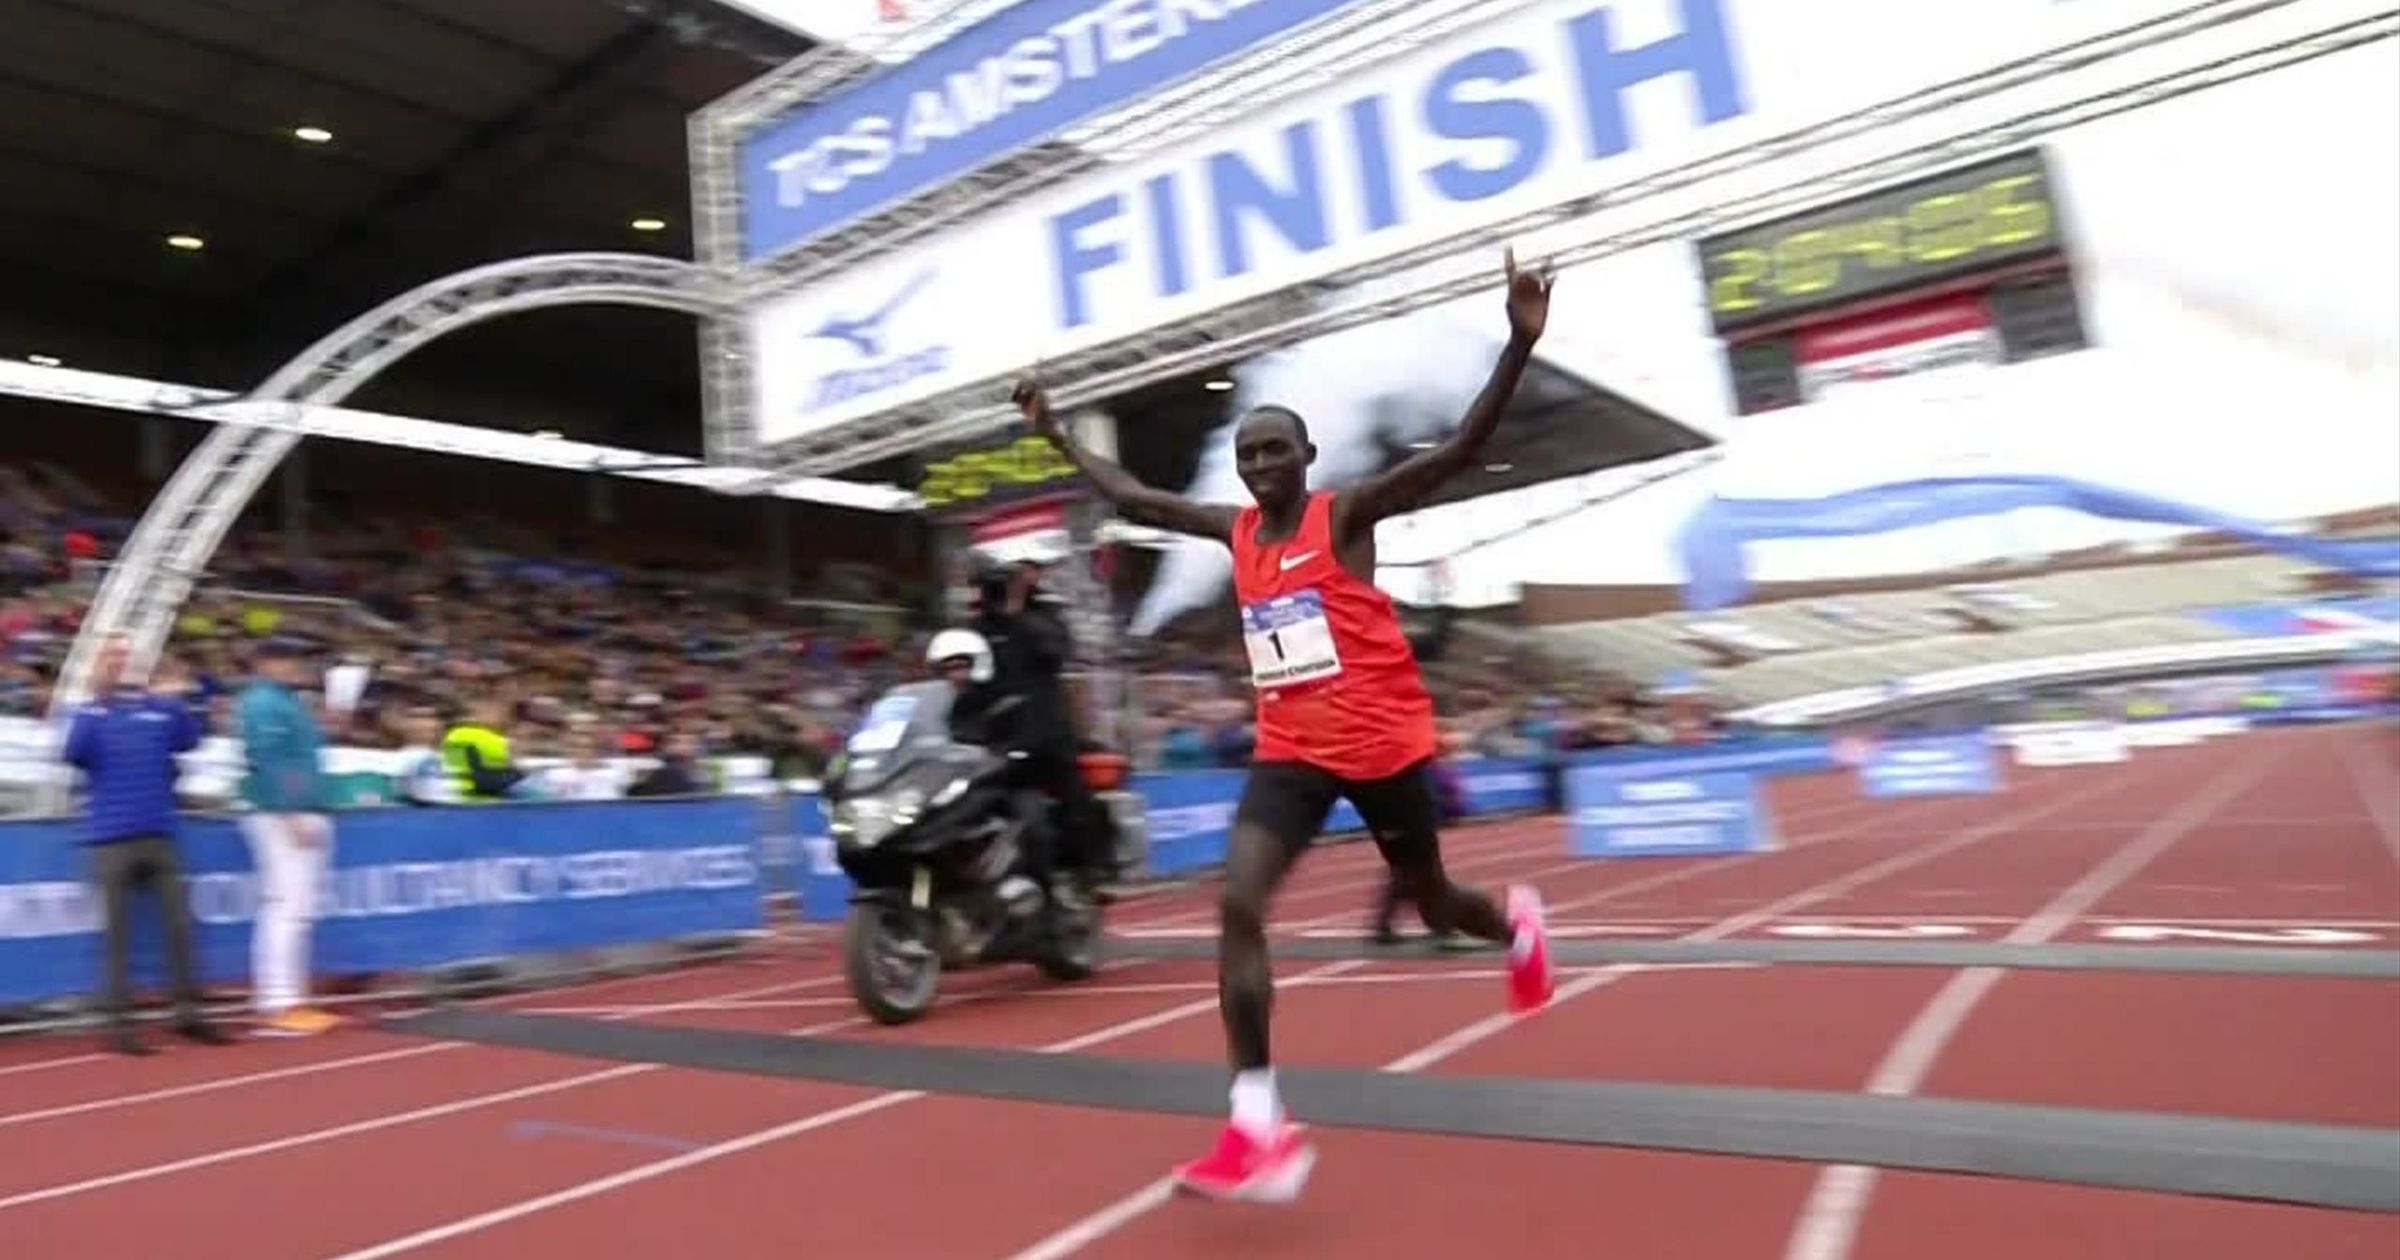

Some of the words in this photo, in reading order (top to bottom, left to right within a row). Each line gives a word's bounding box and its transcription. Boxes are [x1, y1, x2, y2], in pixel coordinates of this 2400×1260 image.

[766, 113, 893, 207] TCS
[899, 0, 1262, 153] AMSTER
[1047, 0, 1750, 329] FINISH
[1268, 630, 1285, 661] 1
